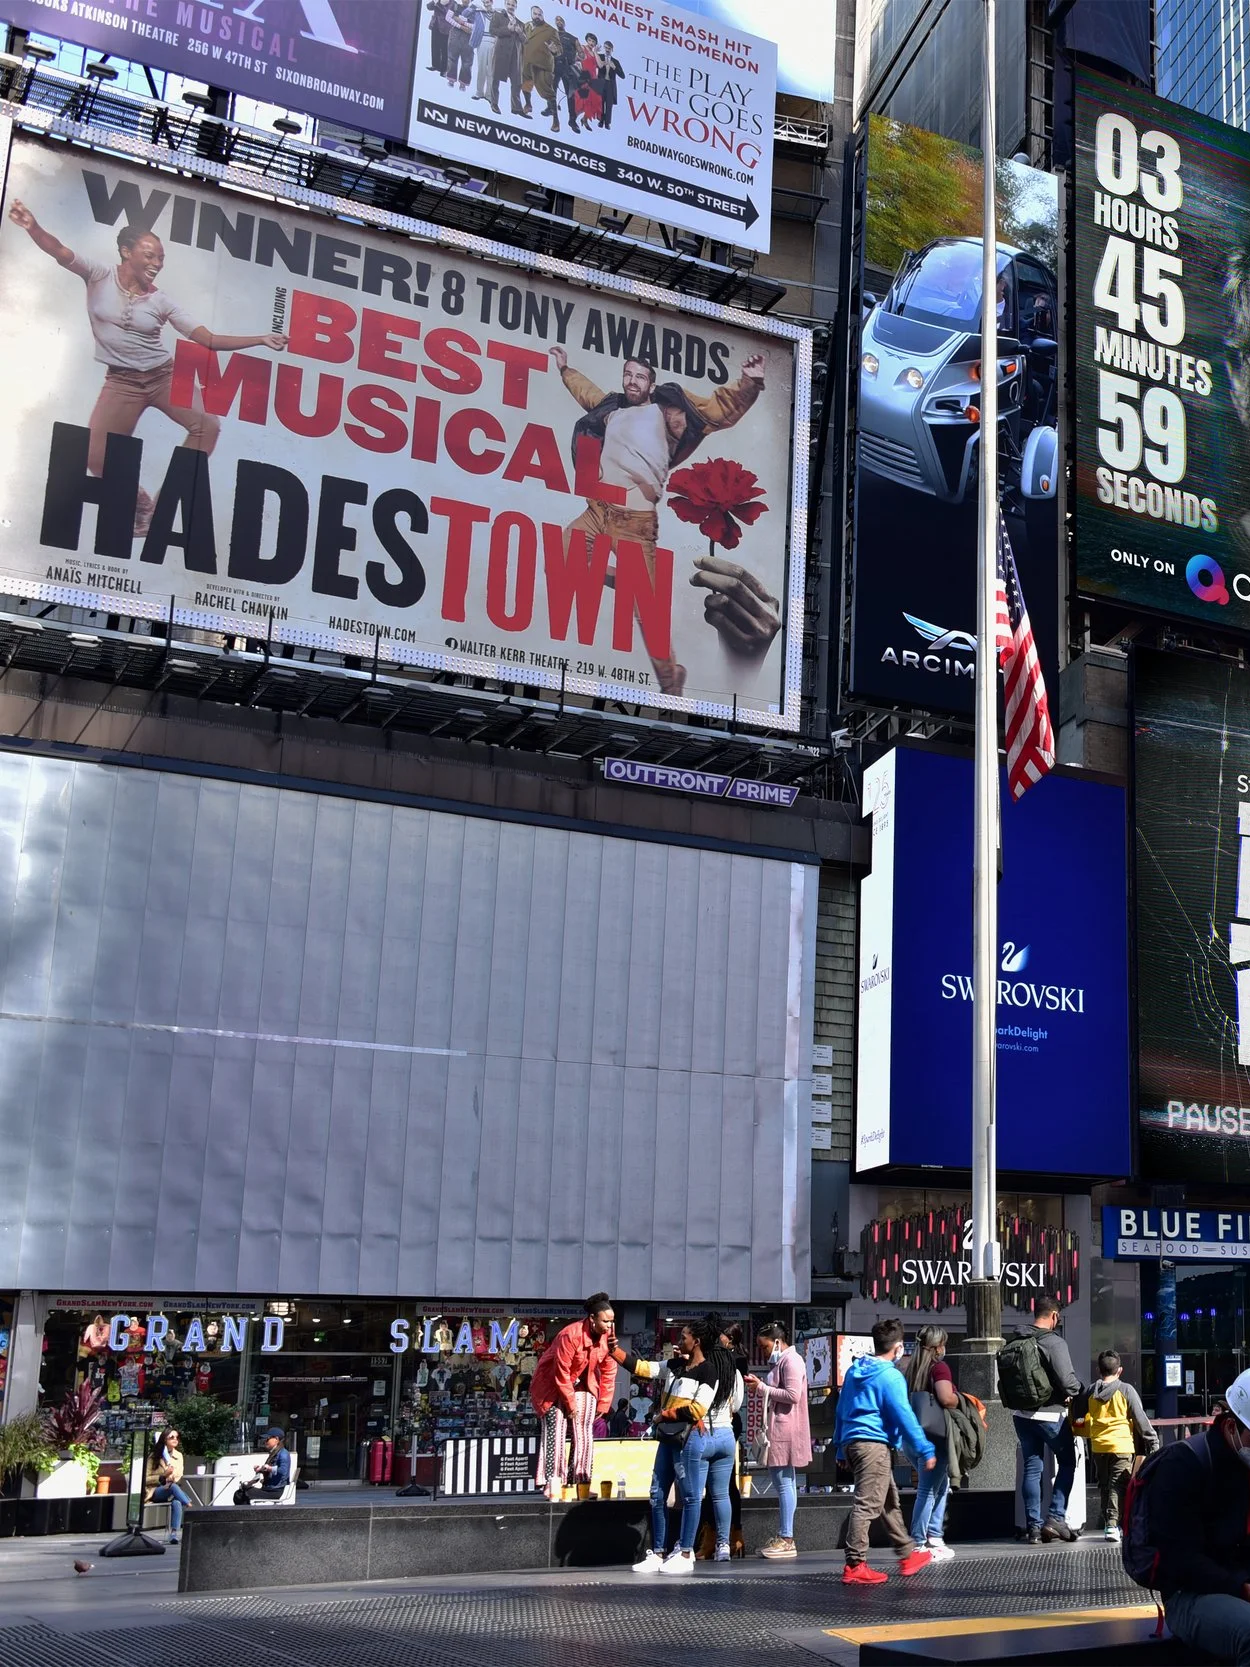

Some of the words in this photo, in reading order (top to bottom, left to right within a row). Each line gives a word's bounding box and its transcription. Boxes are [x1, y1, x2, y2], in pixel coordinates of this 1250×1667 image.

[176, 2, 297, 62] MUSICAL
[637, 22, 759, 74] PHENOMENON
[661, 15, 718, 45] SMASH
[725, 39, 752, 57] HIT
[71, 3, 128, 31] ATKINSON
[131, 20, 179, 47] THEATRE
[187, 38, 208, 56] 256
[212, 45, 222, 60] W
[225, 50, 251, 70] 47TH
[254, 60, 268, 75] ST
[275, 67, 384, 111] SIXONBROADWAY.COM
[642, 56, 682, 83] THE
[689, 67, 754, 107] PLAY
[629, 73, 684, 104] THAT
[689, 94, 763, 136] GOES
[626, 96, 762, 170] WRONG
[455, 116, 492, 136] NEW
[496, 128, 550, 154] WORLD
[553, 147, 606, 173] STAGES
[617, 167, 643, 184] 340
[647, 176, 662, 190] W.
[667, 181, 694, 197] 50TH
[697, 193, 746, 217] STREET
[627, 136, 755, 186] BROADWAYGOESWRONG.COM
[1095, 112, 1184, 213] 03
[1094, 190, 1179, 251] HOURS
[82, 169, 432, 308] WINNER!
[442, 269, 466, 316] 8
[477, 277, 575, 344] TONY
[582, 308, 730, 385] AWARDS
[1093, 234, 1186, 346] 45
[272, 286, 287, 335] INCLUDING
[287, 289, 548, 410] BEST
[1094, 326, 1214, 396] MINUTES
[170, 338, 627, 506] MUSICAL
[1096, 370, 1187, 484] 59
[1096, 466, 1218, 533] SECONDS
[46, 565, 82, 584] ANAÏS
[87, 572, 143, 594] MITCHELL
[84, 562, 100, 570] LYRICS
[1111, 549, 1150, 569] ONLY
[1153, 560, 1175, 576] ON
[195, 591, 236, 612] RACHEL
[241, 600, 288, 620] CHAVKIN
[206, 583, 232, 593] DEVELOPED
[251, 592, 273, 601] DIRECTED
[329, 615, 416, 643] HADESTOWN.COM
[460, 639, 496, 658] WALTER
[500, 647, 526, 664] KERR
[529, 652, 573, 673] THEATRE,
[576, 661, 594, 675] 219
[597, 665, 607, 678] W.
[611, 667, 635, 683] 48TH
[638, 673, 652, 686] ST.
[880, 647, 975, 679] ARCIM
[610, 761, 723, 794] OUTFRONT
[736, 782, 791, 804] PRIME
[941, 974, 1084, 1013] SWROVSKI
[996, 1024, 1048, 1041] arkDelight
[996, 1042, 1039, 1052] arovski.com
[1120, 1209, 1201, 1239] BLUE
[1121, 1242, 1199, 1255] SEAFOOD
[902, 1259, 1045, 1288] SWARVSKI
[108, 1314, 285, 1352] GRAND
[389, 1317, 520, 1354] SLAM
